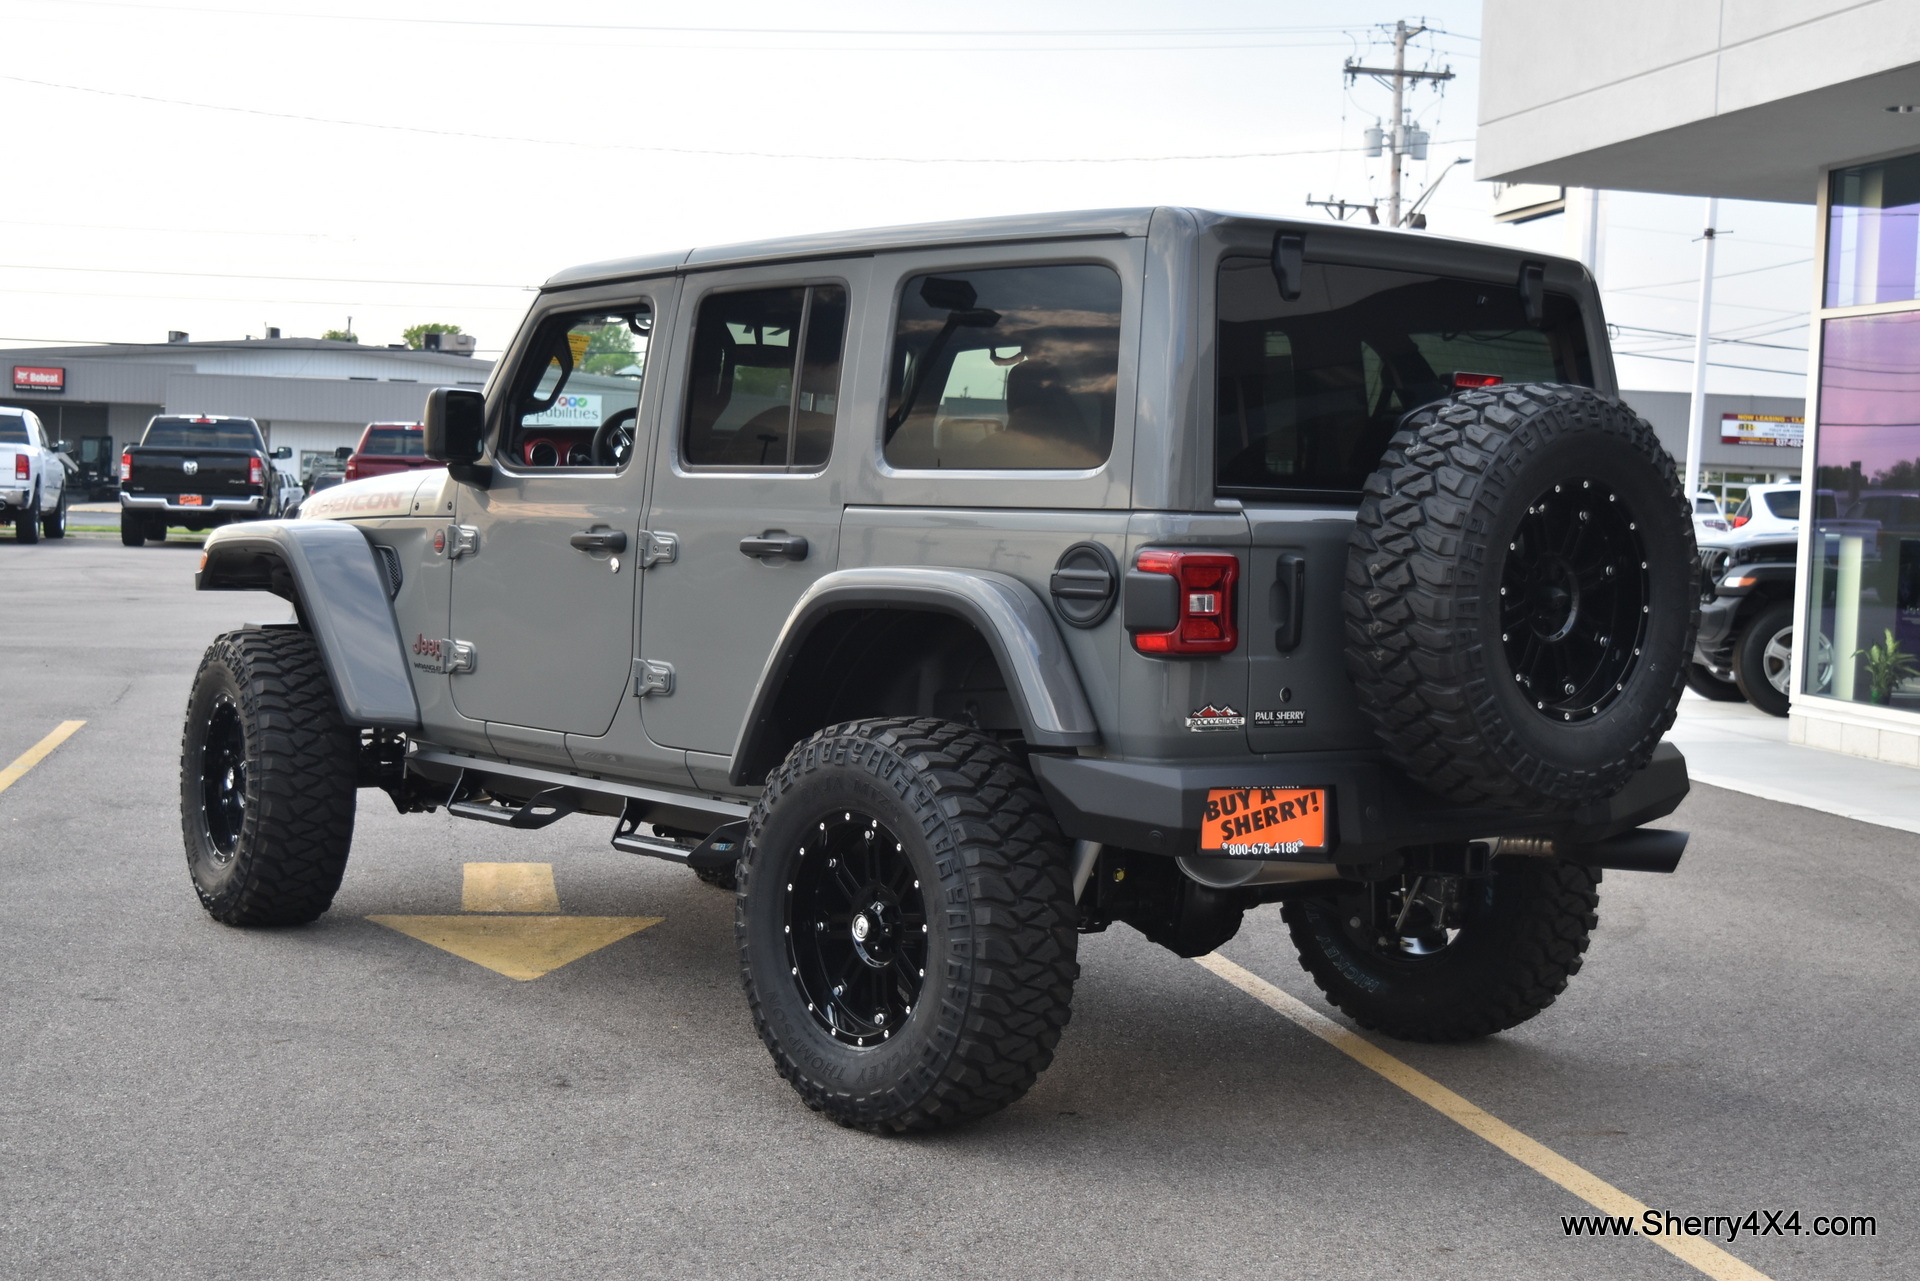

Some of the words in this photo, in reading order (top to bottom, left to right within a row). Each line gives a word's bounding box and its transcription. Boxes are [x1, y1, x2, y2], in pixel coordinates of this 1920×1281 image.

[30, 372, 58, 383] Bobcat
[531, 407, 599, 423] pabilities
[304, 492, 404, 517] RUBICON
[412, 632, 443, 662] Jeep
[1191, 718, 1218, 726] ROCKY
[1255, 711, 1275, 720] PAUL
[1276, 711, 1305, 720] SHERRY
[1205, 790, 1251, 822] BUY
[1260, 790, 1276, 805] A
[1220, 791, 1319, 841] SHERRY!
[1228, 842, 1299, 855] 800-678-4188
